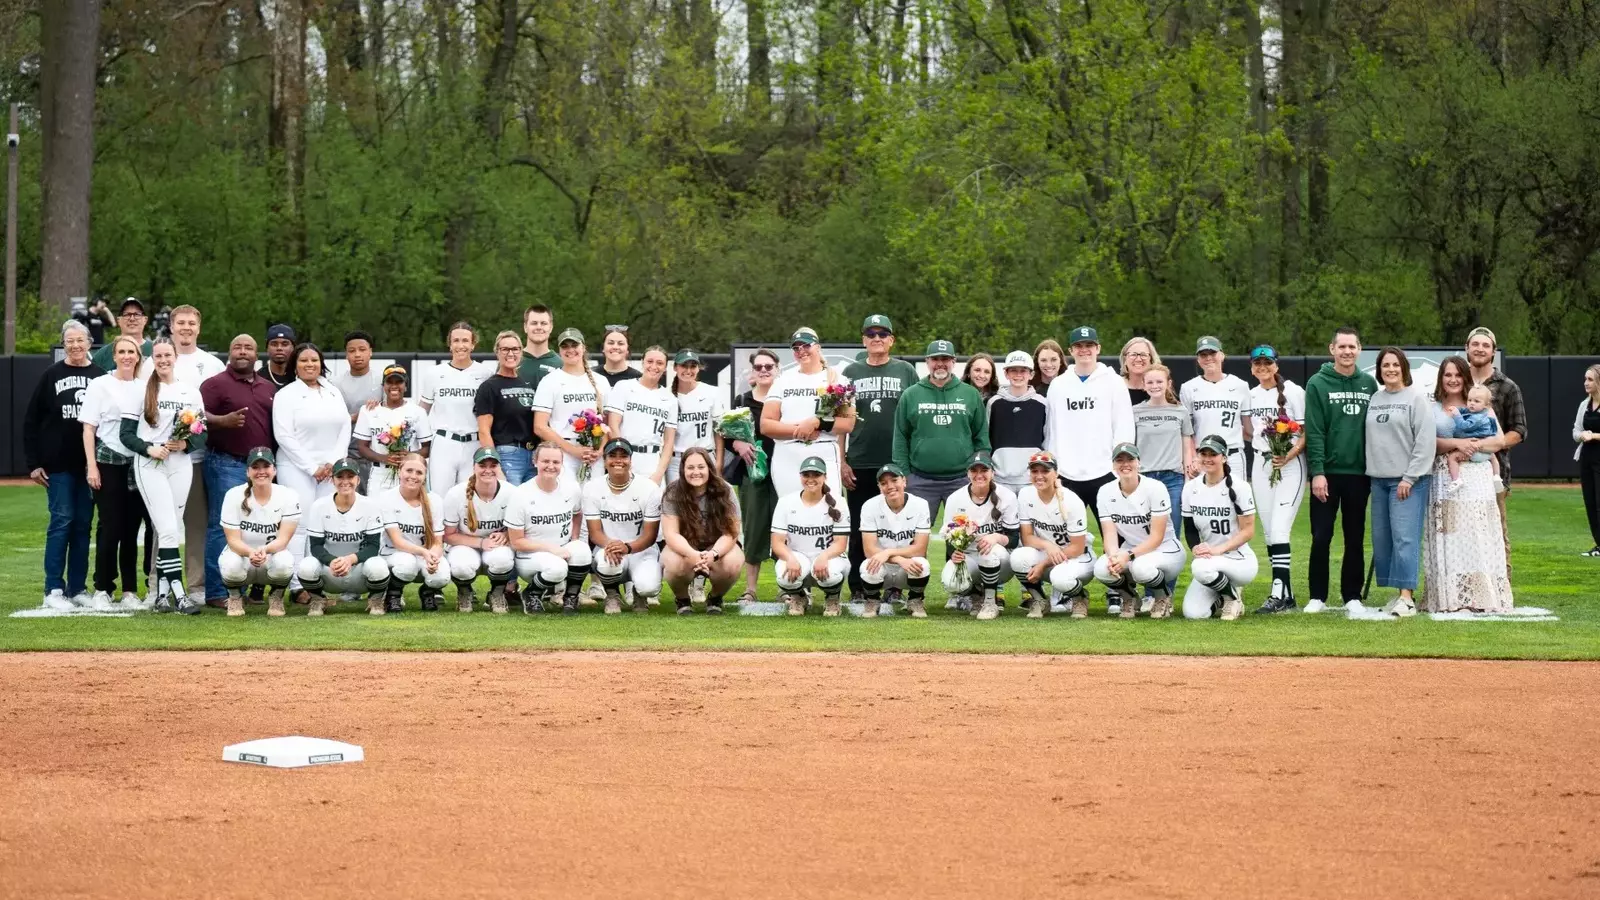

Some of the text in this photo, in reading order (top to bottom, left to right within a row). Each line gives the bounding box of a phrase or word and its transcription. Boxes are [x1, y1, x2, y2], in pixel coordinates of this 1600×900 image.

[1081, 328, 1089, 337] S
[938, 340, 947, 351] S
[54, 376, 86, 396] MICHIGAN
[882, 376, 901, 392] STATE
[439, 388, 478, 397] SPARTAN
[563, 393, 597, 404] SPARTA
[783, 387, 819, 398] SPARTA
[1066, 396, 1094, 411] levi's
[1193, 400, 1239, 411] SPARTANS
[626, 402, 669, 420] SPARTANS
[678, 411, 709, 423] ARTANS
[1221, 411, 1235, 428] 21
[652, 418, 666, 437] 14
[695, 422, 707, 439] 19
[531, 510, 572, 525] SPARTANS
[600, 509, 643, 522] SPARTANS
[240, 520, 282, 534] SPARTAN
[398, 523, 425, 534] PARTA
[634, 520, 643, 536] 7
[787, 524, 834, 536] SPARTANS
[1210, 519, 1231, 535] 90
[815, 534, 834, 550] 42
